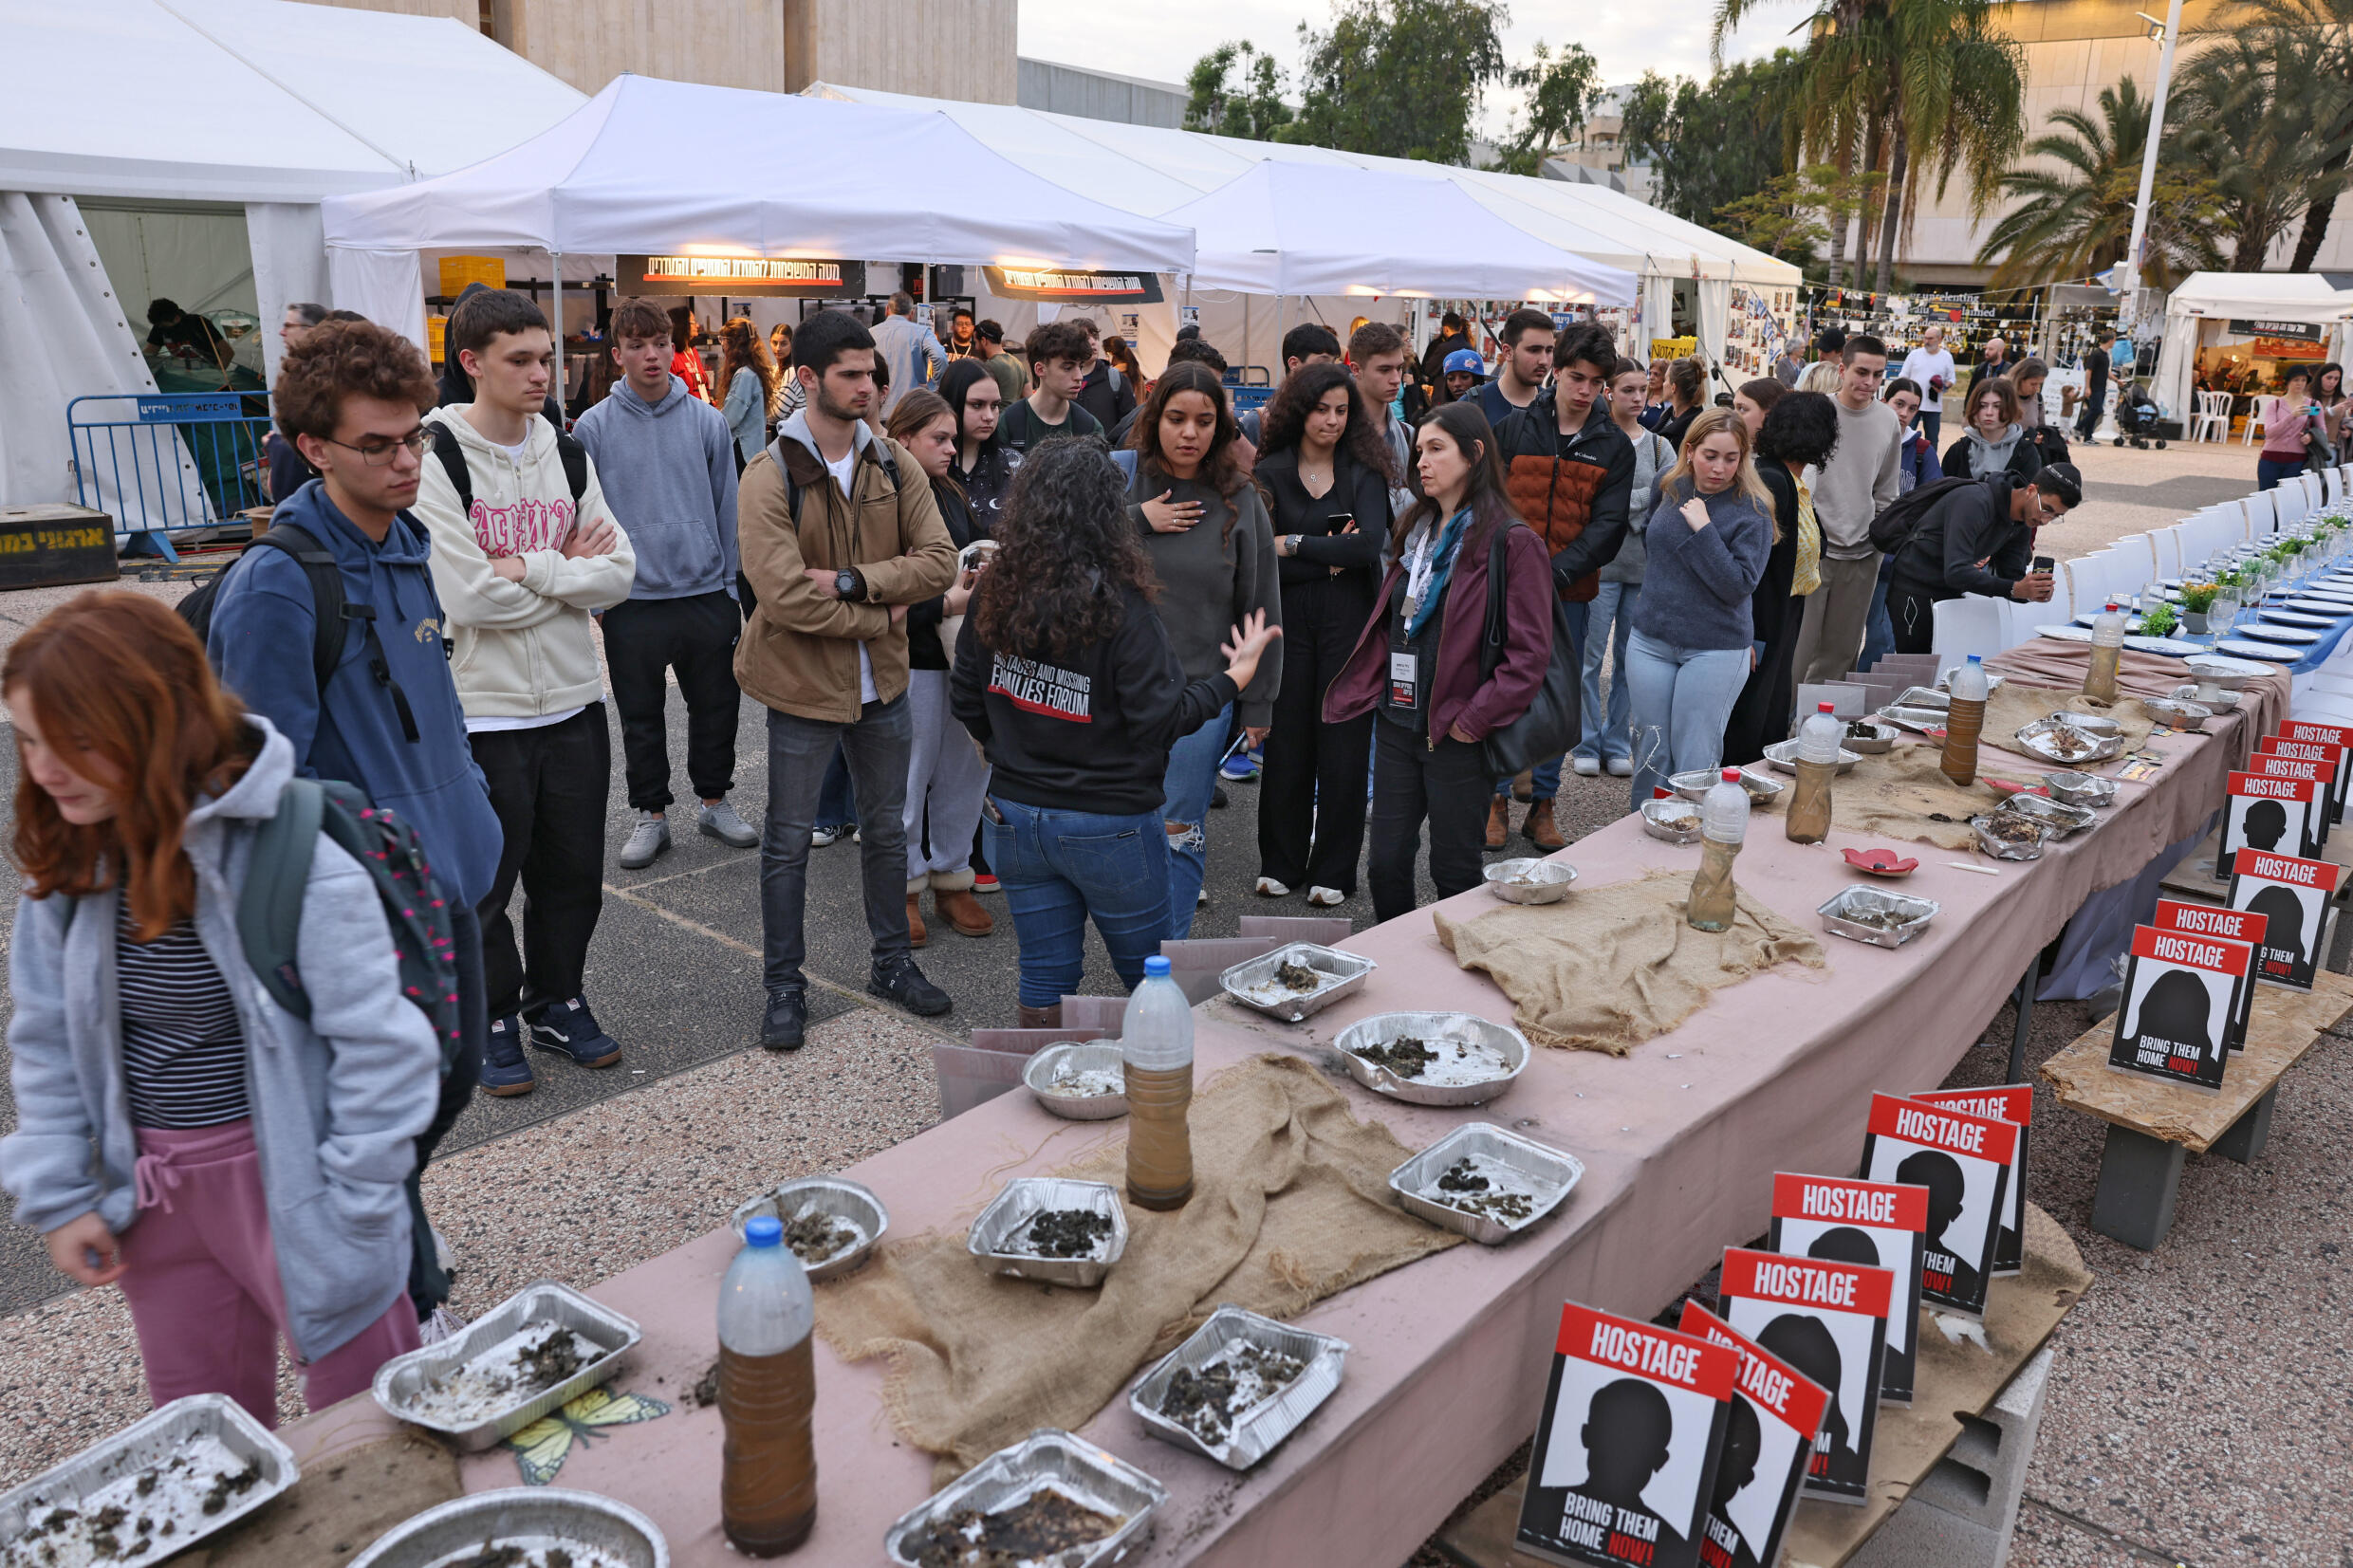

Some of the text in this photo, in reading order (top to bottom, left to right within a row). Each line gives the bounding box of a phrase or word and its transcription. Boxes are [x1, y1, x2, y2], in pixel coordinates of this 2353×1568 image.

[769, 261, 817, 280] המשפחות
[819, 264, 840, 281] מטה
[991, 663, 1090, 717] FAMILIES FORUM
[1036, 663, 1056, 683] AND
[1055, 668, 1091, 693] MISSING
[2292, 724, 2343, 745] HOSTAGE
[2275, 741, 2326, 760] HOSTAGE
[2265, 759, 2318, 779] HOSTAGE
[2243, 778, 2298, 798] HOSTAGE
[2253, 856, 2318, 884] HOSTAGE
[2175, 908, 2244, 936] HOSTAGE
[2153, 935, 2226, 968] HOSTAGE
[2270, 948, 2295, 965] THEM
[2265, 960, 2292, 977] NOW!
[2139, 1034, 2201, 1061] BRING THEM
[2136, 1048, 2198, 1075] HOME NOW!
[1896, 1107, 1988, 1153] HOSTAGE
[1802, 1184, 1897, 1223] HOSTAGE
[1753, 1261, 1859, 1307] HOSTAGE
[1922, 1269, 1954, 1294] OW!
[1589, 1320, 1702, 1385] HOSTAGE
[1564, 1491, 1660, 1543] BRING THEM
[1558, 1516, 1655, 1567] HOME NOW!
